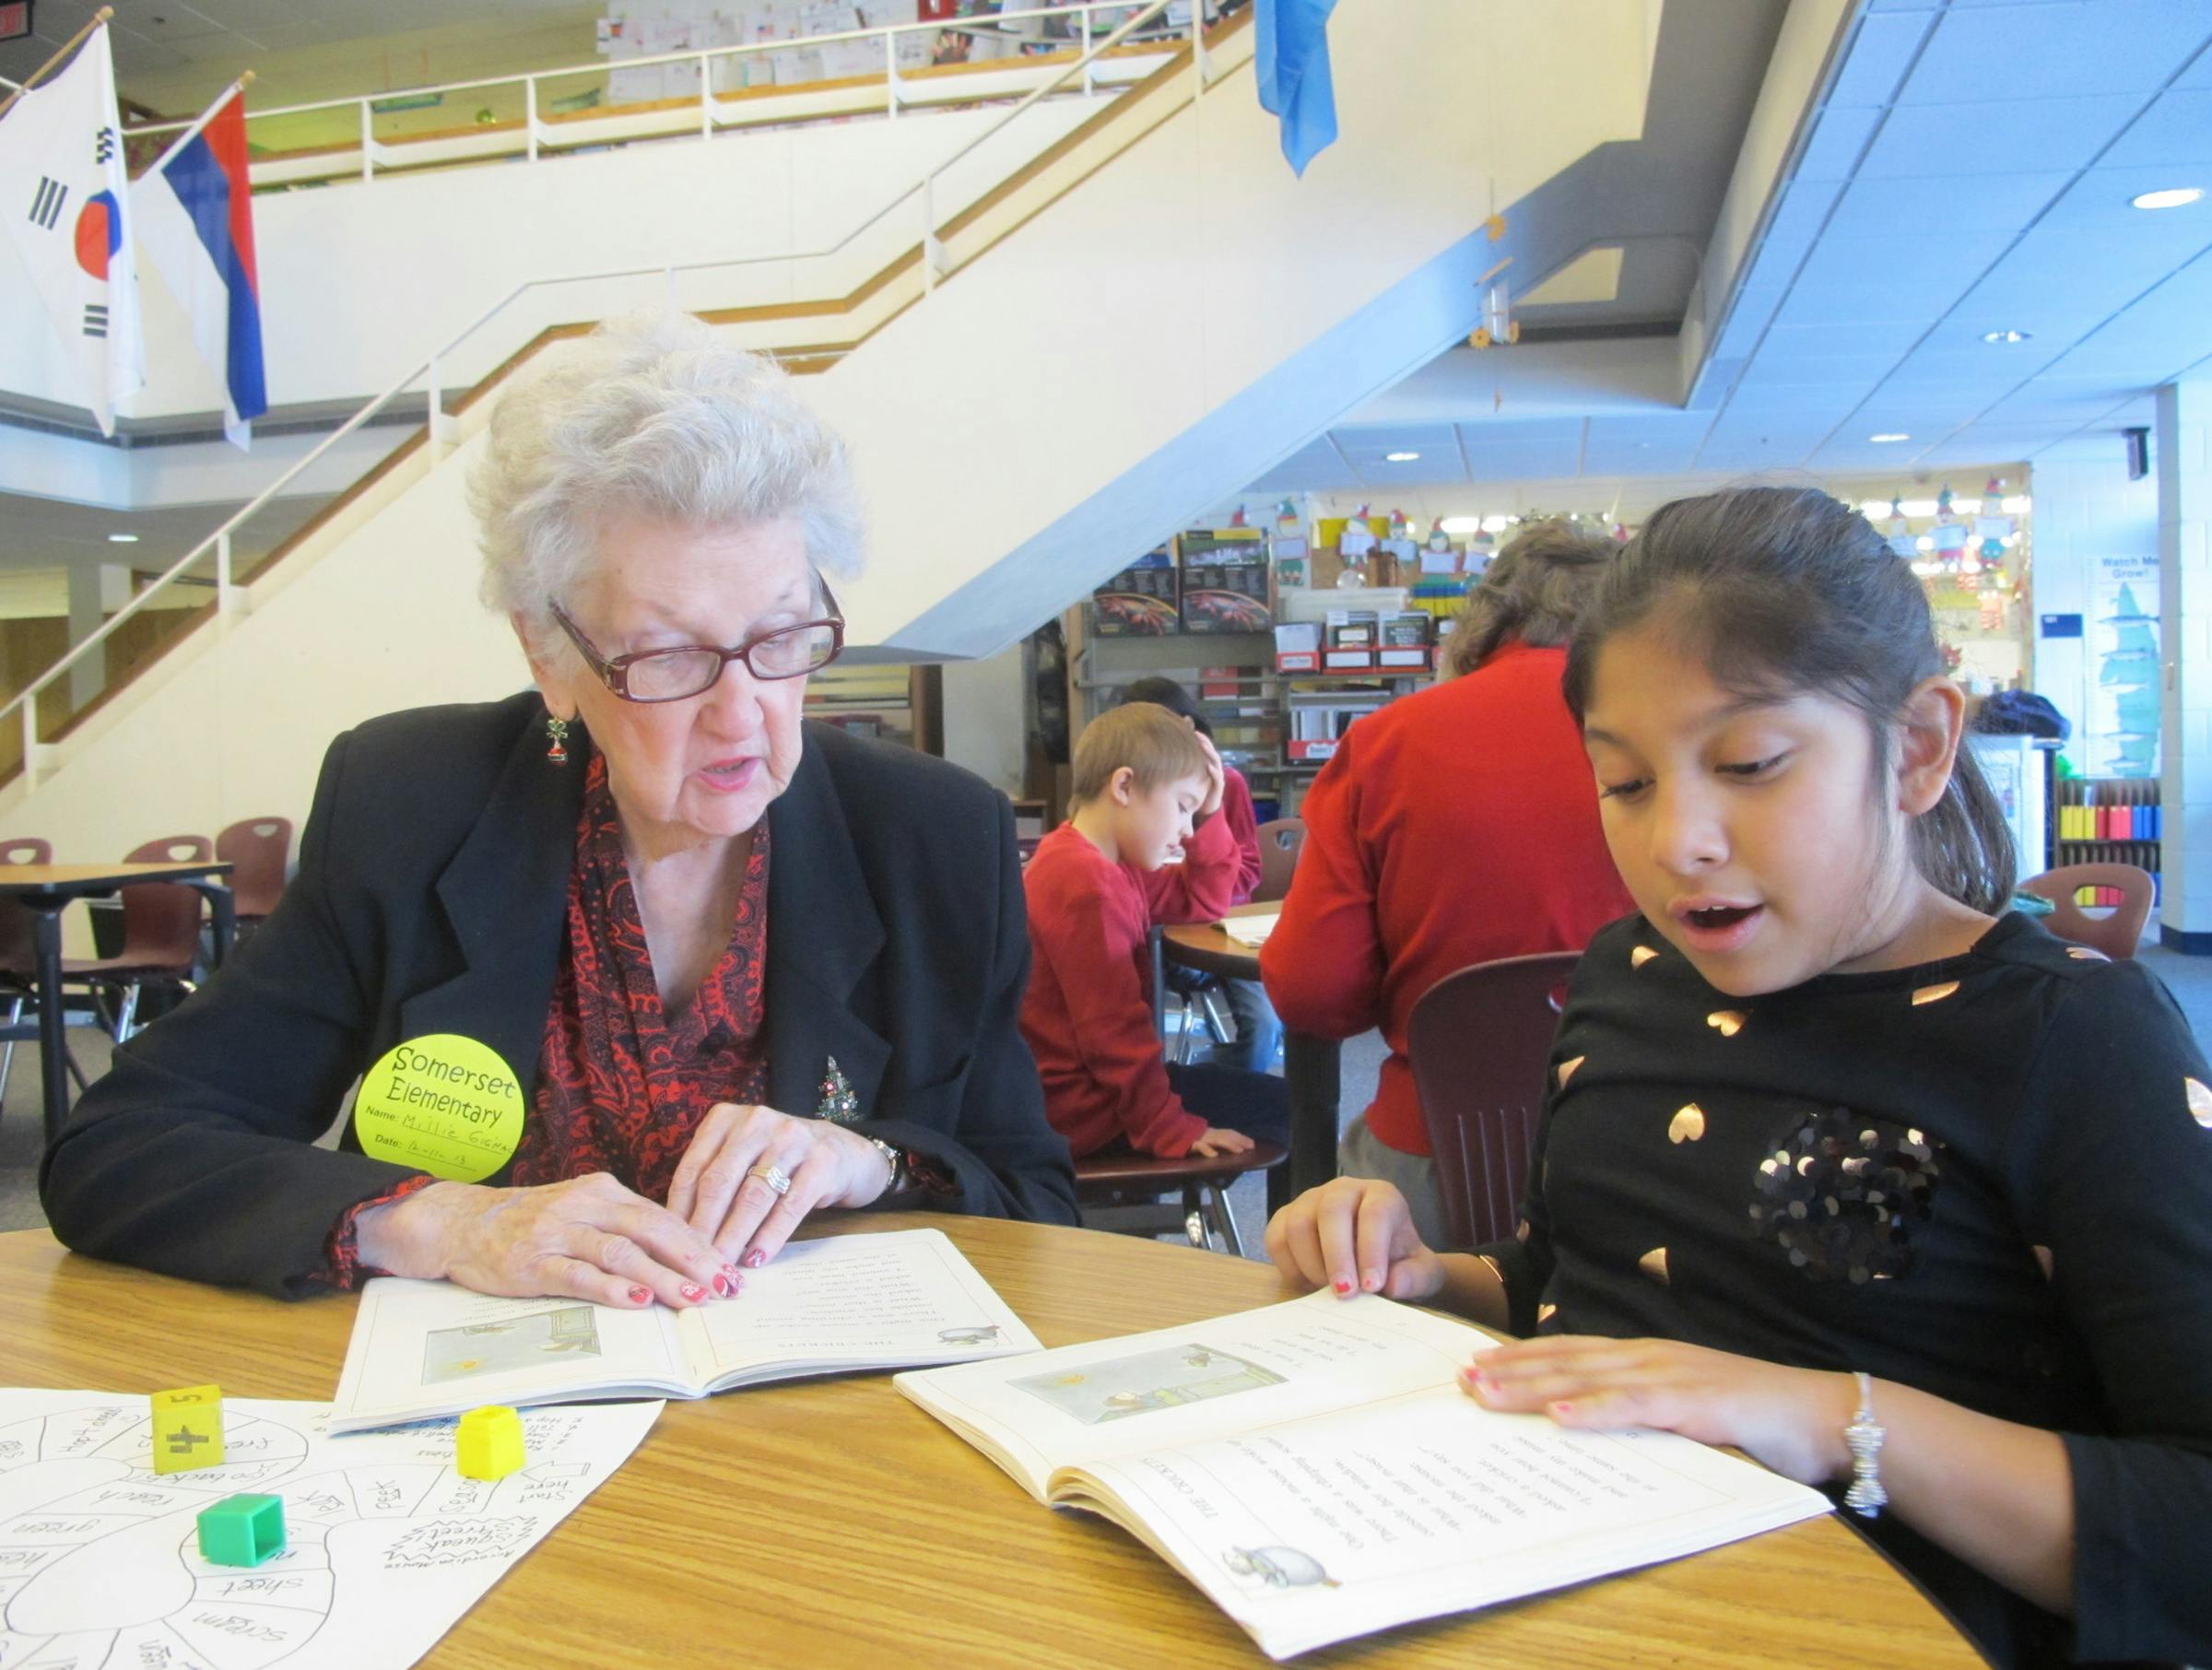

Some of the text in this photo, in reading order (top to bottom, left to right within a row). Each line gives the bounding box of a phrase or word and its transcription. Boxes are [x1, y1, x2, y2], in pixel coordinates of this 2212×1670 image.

[2102, 556, 2159, 567] Watch Me
[392, 1046, 516, 1099] Somerset
[386, 1076, 503, 1128] Elementary
[365, 1105, 400, 1122] Name:
[374, 1134, 402, 1149] Date:
[524, 1480, 569, 1489] here
[92, 1489, 174, 1506] reach
[368, 1479, 406, 1509] peek
[519, 1489, 573, 1503] Start
[1189, 1497, 1219, 1519] THE
[13, 1519, 100, 1535] green
[420, 1532, 512, 1553] Squeak
[220, 1577, 304, 1596] sheet
[193, 1613, 288, 1641] scream
